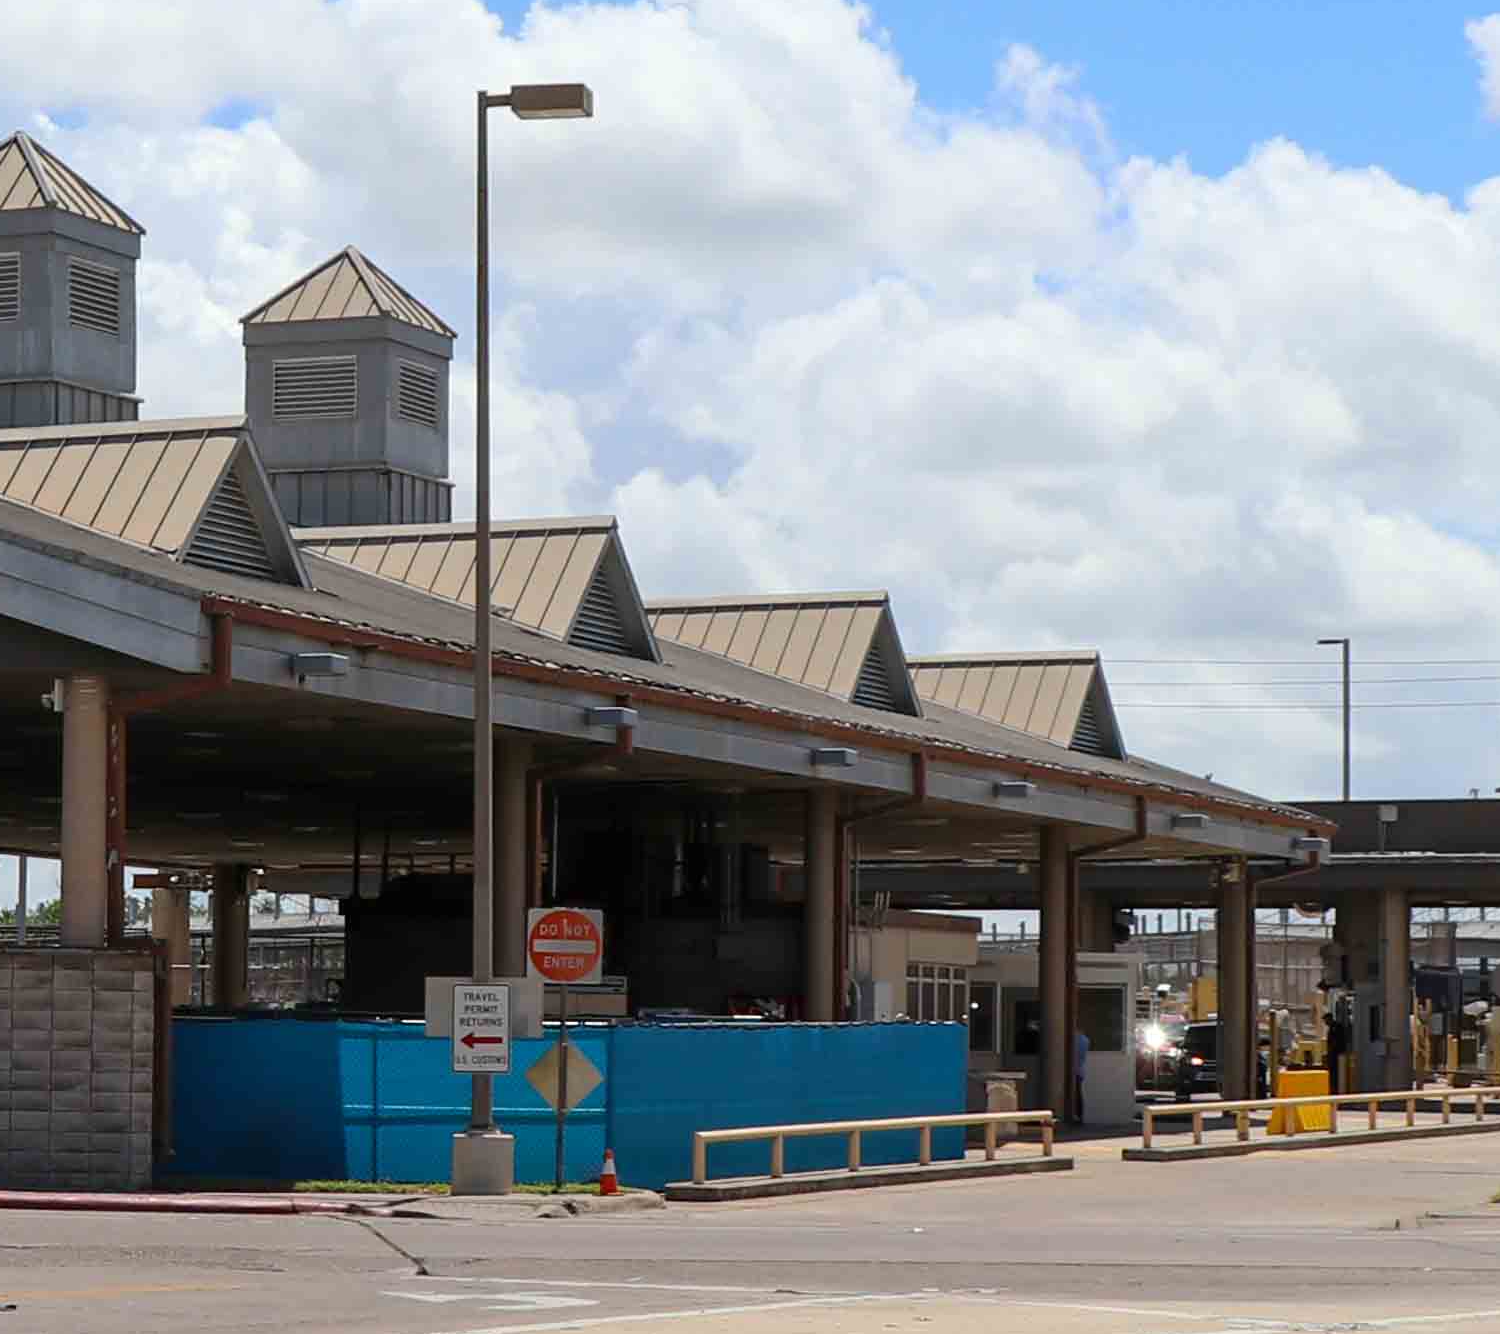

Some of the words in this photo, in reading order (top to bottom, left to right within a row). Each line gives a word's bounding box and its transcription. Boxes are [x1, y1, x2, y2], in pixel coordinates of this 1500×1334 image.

[539, 923, 558, 937] DO
[563, 923, 591, 938] NOT
[543, 955, 584, 970] ENTER
[464, 992, 500, 1002] TRAVEL
[464, 1005, 498, 1014] PERMIT
[459, 1017, 503, 1027] RETURNS
